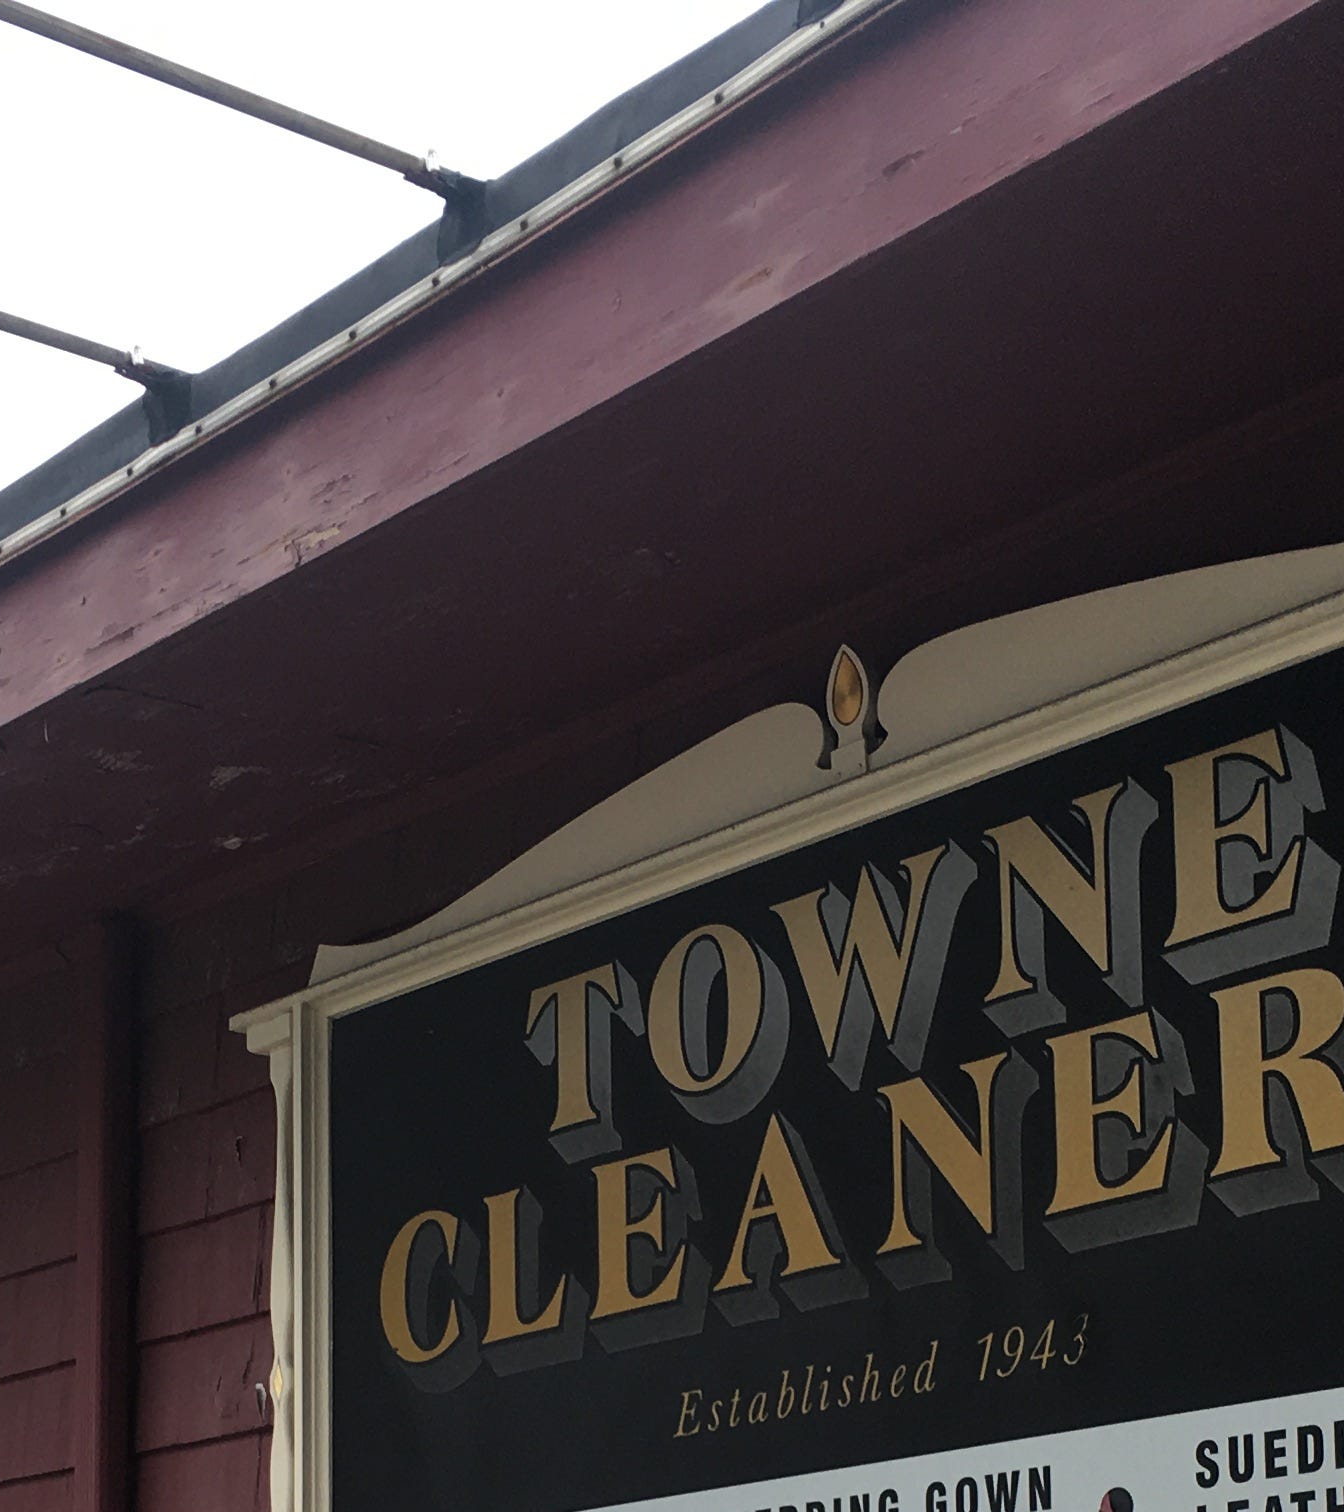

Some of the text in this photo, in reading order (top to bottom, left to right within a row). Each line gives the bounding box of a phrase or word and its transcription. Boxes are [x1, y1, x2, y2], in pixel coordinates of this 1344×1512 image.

[523, 726, 1316, 1142] TOWNE
[674, 1313, 1088, 1438] Established 1943
